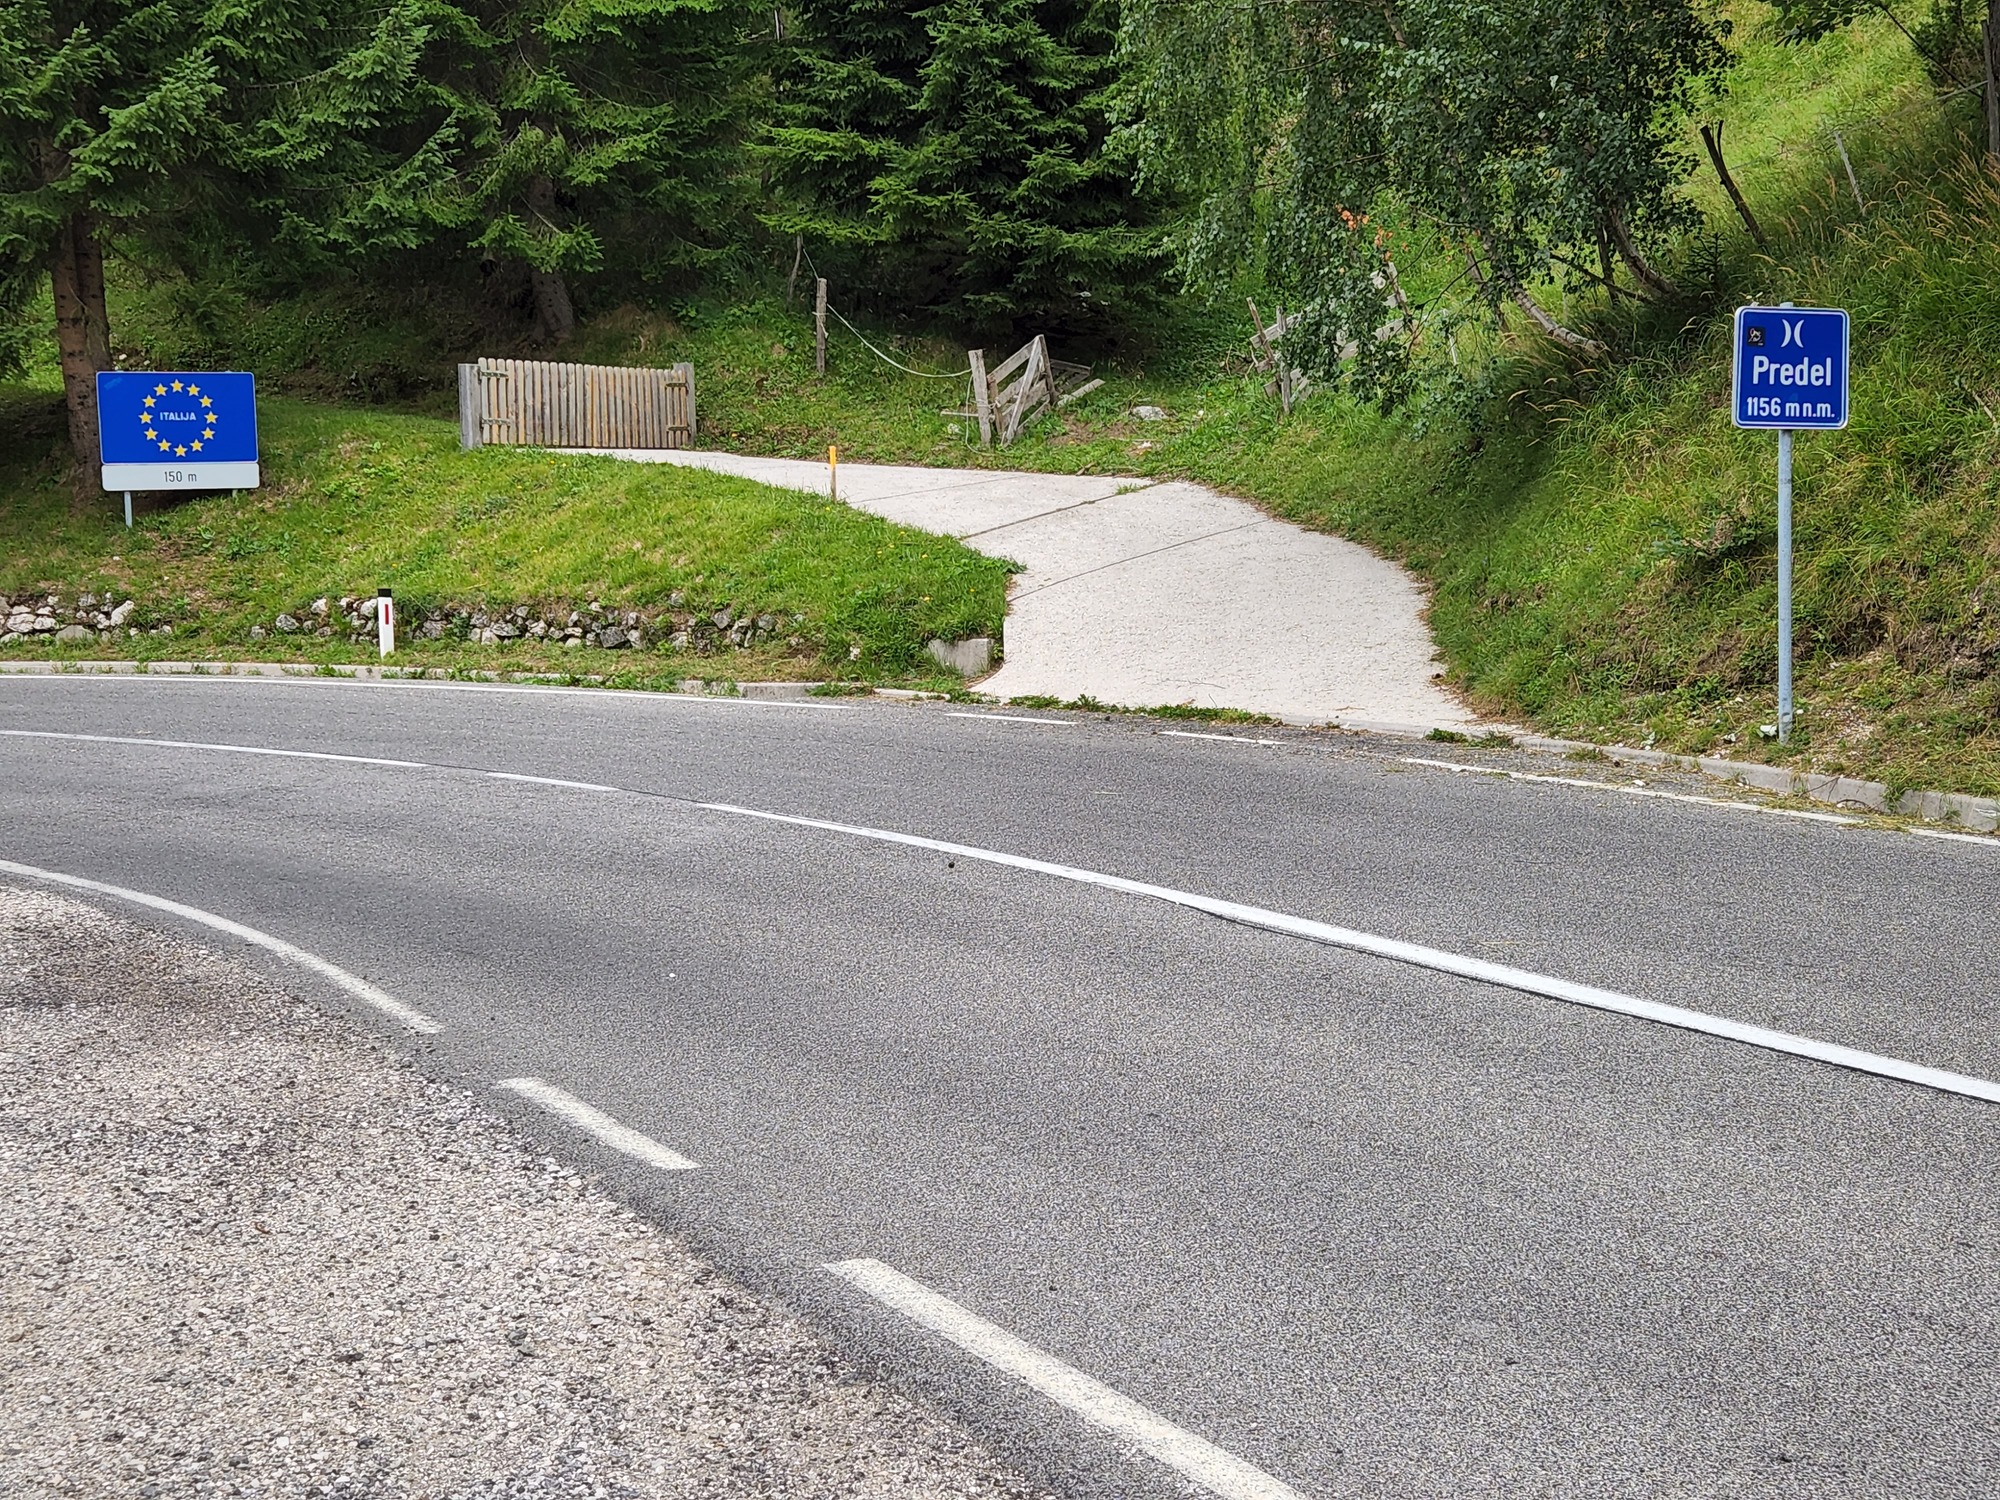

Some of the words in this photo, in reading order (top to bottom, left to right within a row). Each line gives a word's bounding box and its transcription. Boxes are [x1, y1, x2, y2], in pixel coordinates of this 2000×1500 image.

[1753, 355, 1832, 386] Predel
[1746, 396, 1781, 417] 1156
[159, 411, 197, 421] ITALIJA
[164, 471, 183, 482] 150
[188, 472, 198, 482] m
